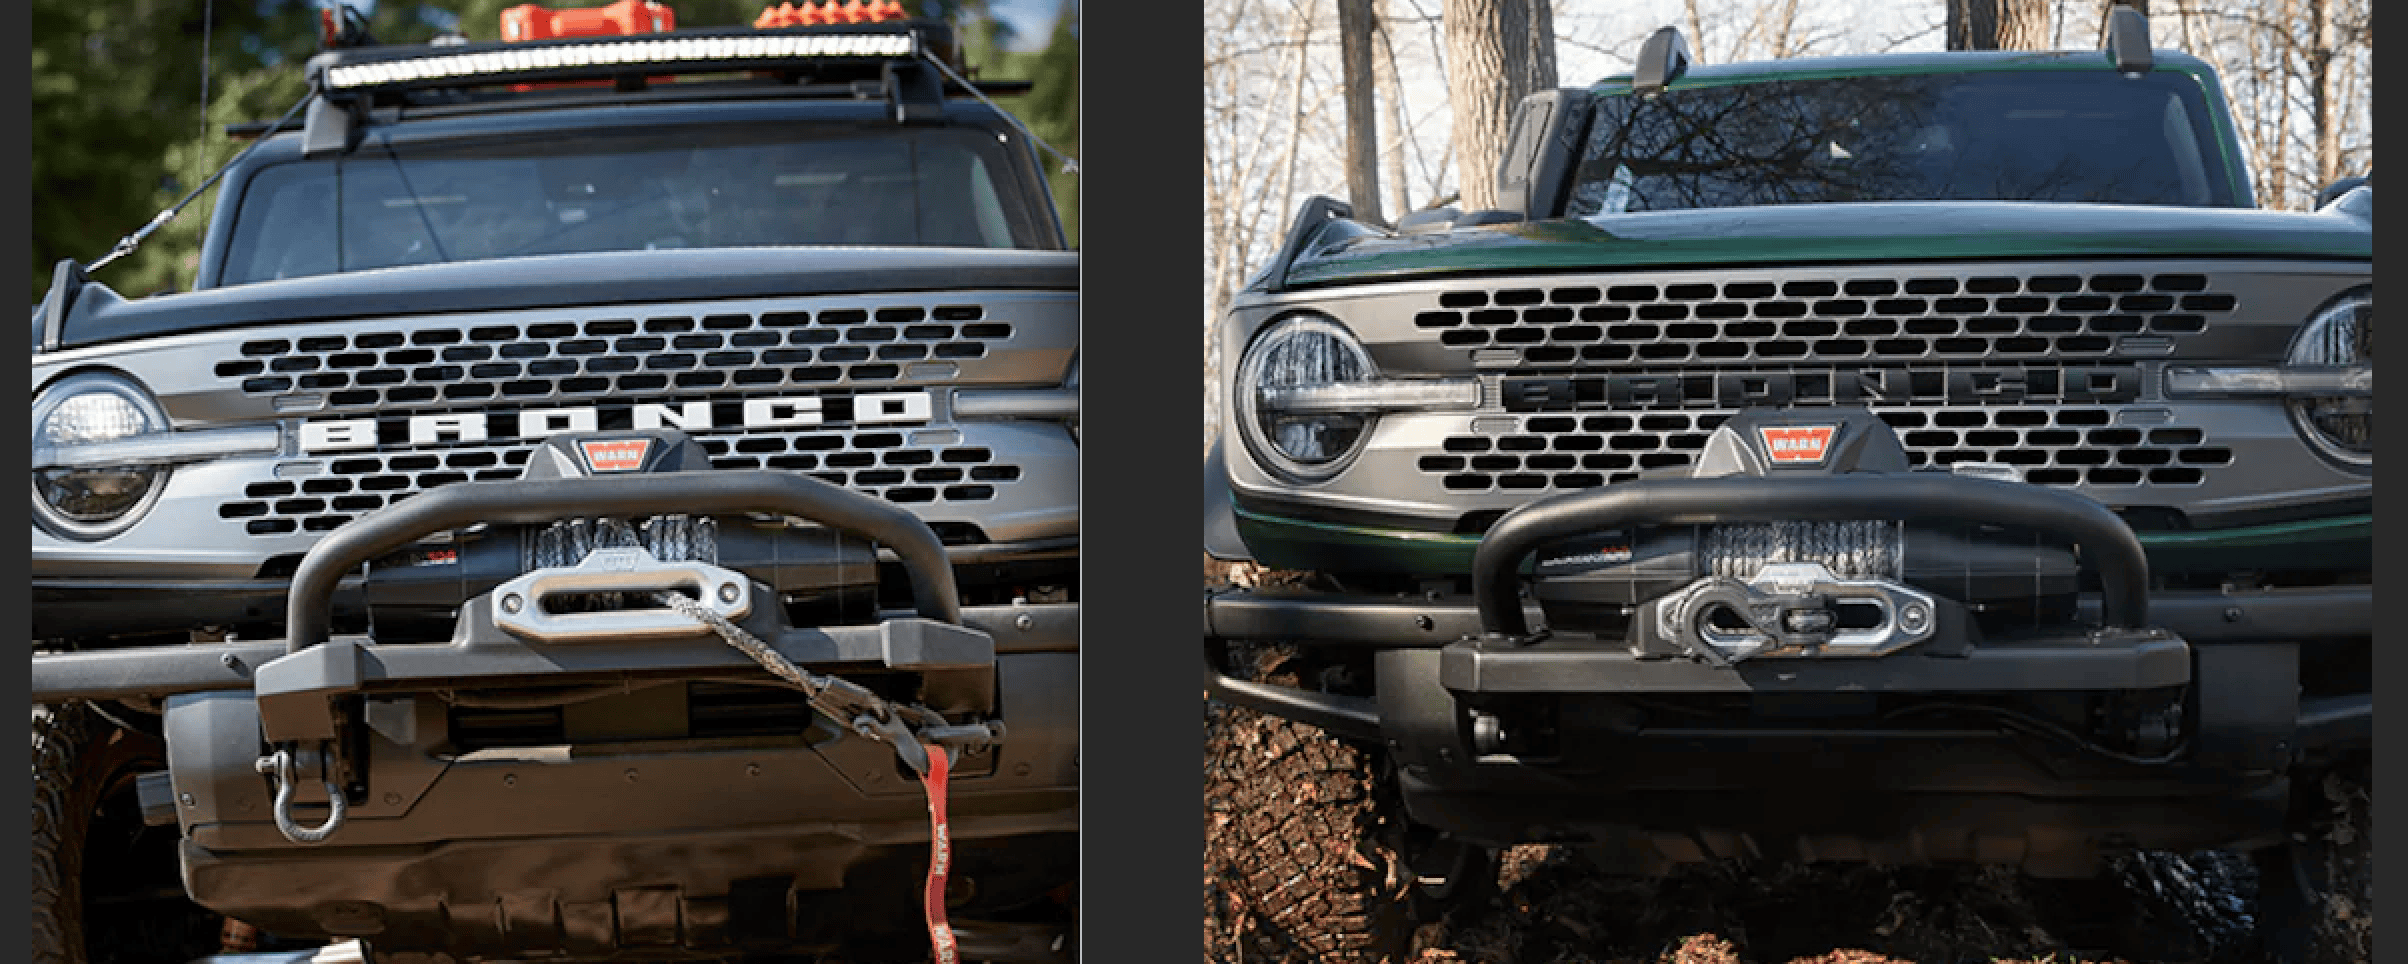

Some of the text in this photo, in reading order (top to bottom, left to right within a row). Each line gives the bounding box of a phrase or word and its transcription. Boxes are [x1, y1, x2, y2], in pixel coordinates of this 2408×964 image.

[1503, 368, 2138, 410] BRONCO
[299, 391, 932, 452] BRONCO
[593, 449, 638, 461] WARN
[1773, 439, 1821, 451] WARN
[936, 824, 948, 875] WARN
[934, 923, 954, 964] WAR
